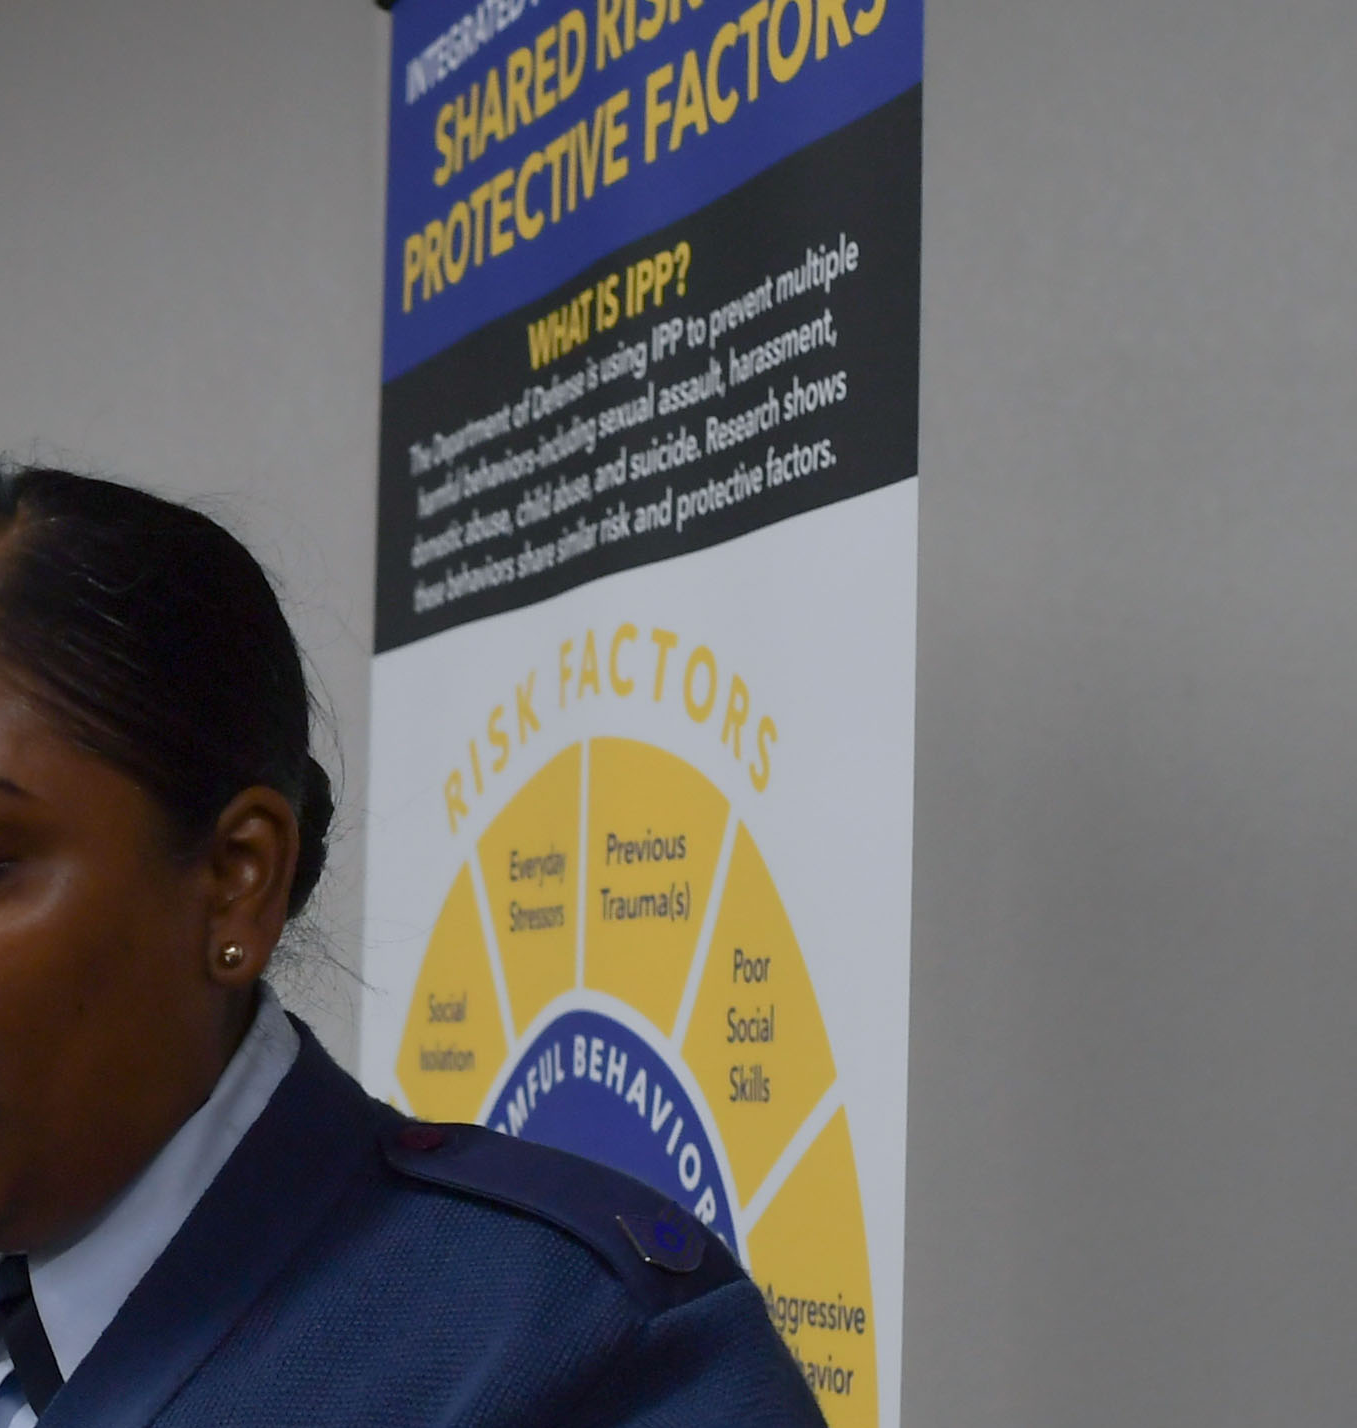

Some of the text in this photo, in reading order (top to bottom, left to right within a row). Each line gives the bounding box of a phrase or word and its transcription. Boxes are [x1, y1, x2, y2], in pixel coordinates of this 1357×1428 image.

[434, 9, 587, 187] SHARED
[402, 89, 629, 313] PROTECTIVE
[512, 388, 531, 429] of
[586, 355, 598, 391] is
[600, 340, 649, 384] using
[652, 317, 683, 362] IPP
[686, 315, 706, 348] to
[709, 276, 773, 350] prevent
[776, 232, 860, 303] multiple
[528, 241, 691, 370] WHAT IS IPP?
[598, 380, 655, 438] sexual
[657, 356, 726, 416] assault,
[729, 307, 837, 386] harassment,
[515, 482, 552, 528] child
[594, 445, 627, 494] and
[629, 426, 702, 481] suicide.
[706, 386, 780, 455] Research
[783, 369, 847, 422] shows
[600, 500, 631, 545] risk
[634, 485, 673, 534] and
[676, 460, 764, 533] protective
[766, 438, 837, 489] factors.
[443, 620, 778, 836] RISK FACTORS
[508, 842, 567, 886] Everyday
[605, 831, 687, 867] Previous
[508, 899, 565, 935] Stressors
[599, 882, 691, 923] Trauma(s)
[732, 947, 771, 984] Poor
[427, 990, 468, 1024] Social
[726, 1003, 775, 1045] Social
[729, 1064, 771, 1104] Skills
[572, 1033, 729, 1247] BEHAVIOR
[765, 1283, 866, 1335] Aggressive
